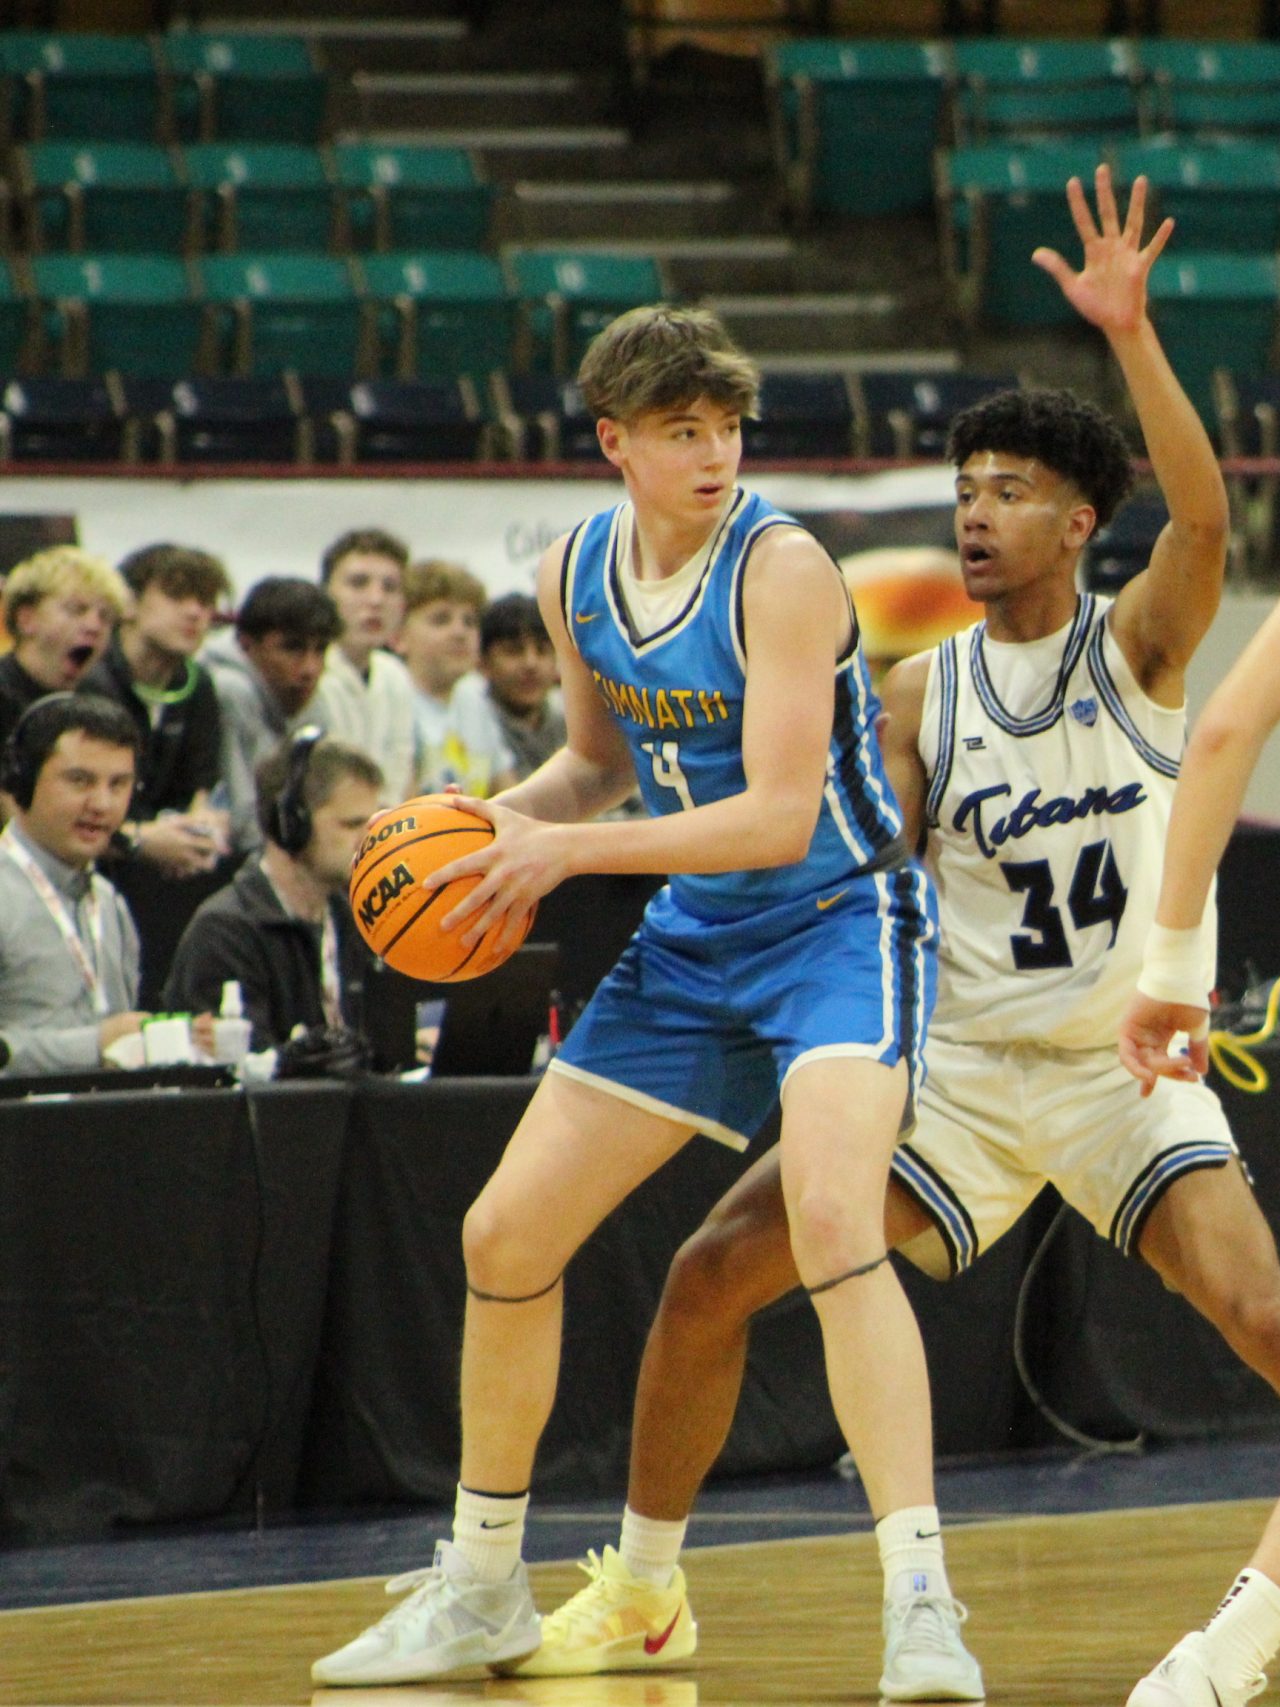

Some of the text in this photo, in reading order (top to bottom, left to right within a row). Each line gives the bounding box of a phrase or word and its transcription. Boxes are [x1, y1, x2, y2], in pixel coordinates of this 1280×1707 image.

[640, 740, 697, 811] 4
[357, 862, 416, 934] NCAA
[998, 838, 1129, 970] 34
